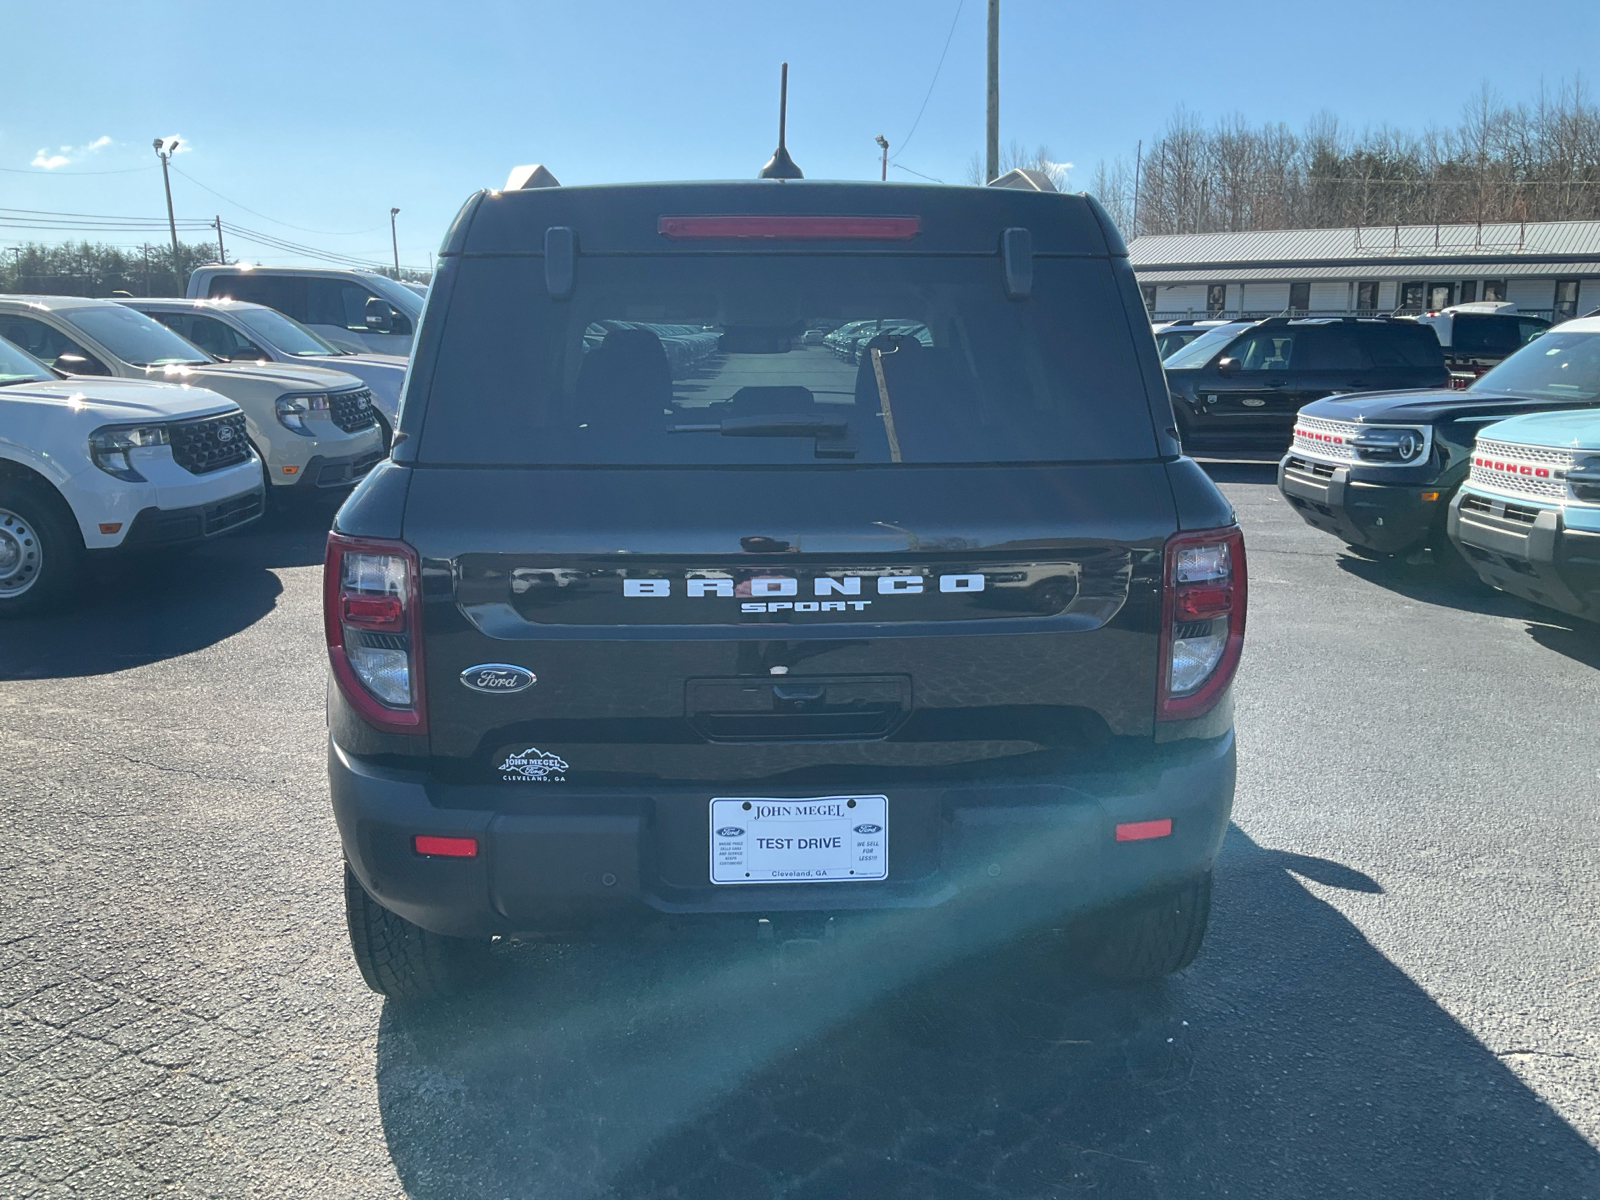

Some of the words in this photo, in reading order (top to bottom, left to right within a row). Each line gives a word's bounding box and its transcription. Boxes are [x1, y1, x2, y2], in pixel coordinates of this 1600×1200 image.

[1296, 429, 1343, 444] BRONCO
[1475, 457, 1549, 477] BRONCO
[622, 573, 985, 598] BRONCO
[740, 600, 872, 613] SPORT
[476, 669, 518, 687] Ford
[505, 758, 528, 768] JOHN
[529, 758, 560, 767] MEGEL
[524, 766, 545, 775] Ford
[754, 805, 792, 820] JOHN
[795, 804, 845, 818] MEGEL
[721, 827, 741, 836] Ford
[858, 824, 877, 833] Ford
[756, 838, 794, 850] TEST
[797, 837, 842, 850] DRIVE
